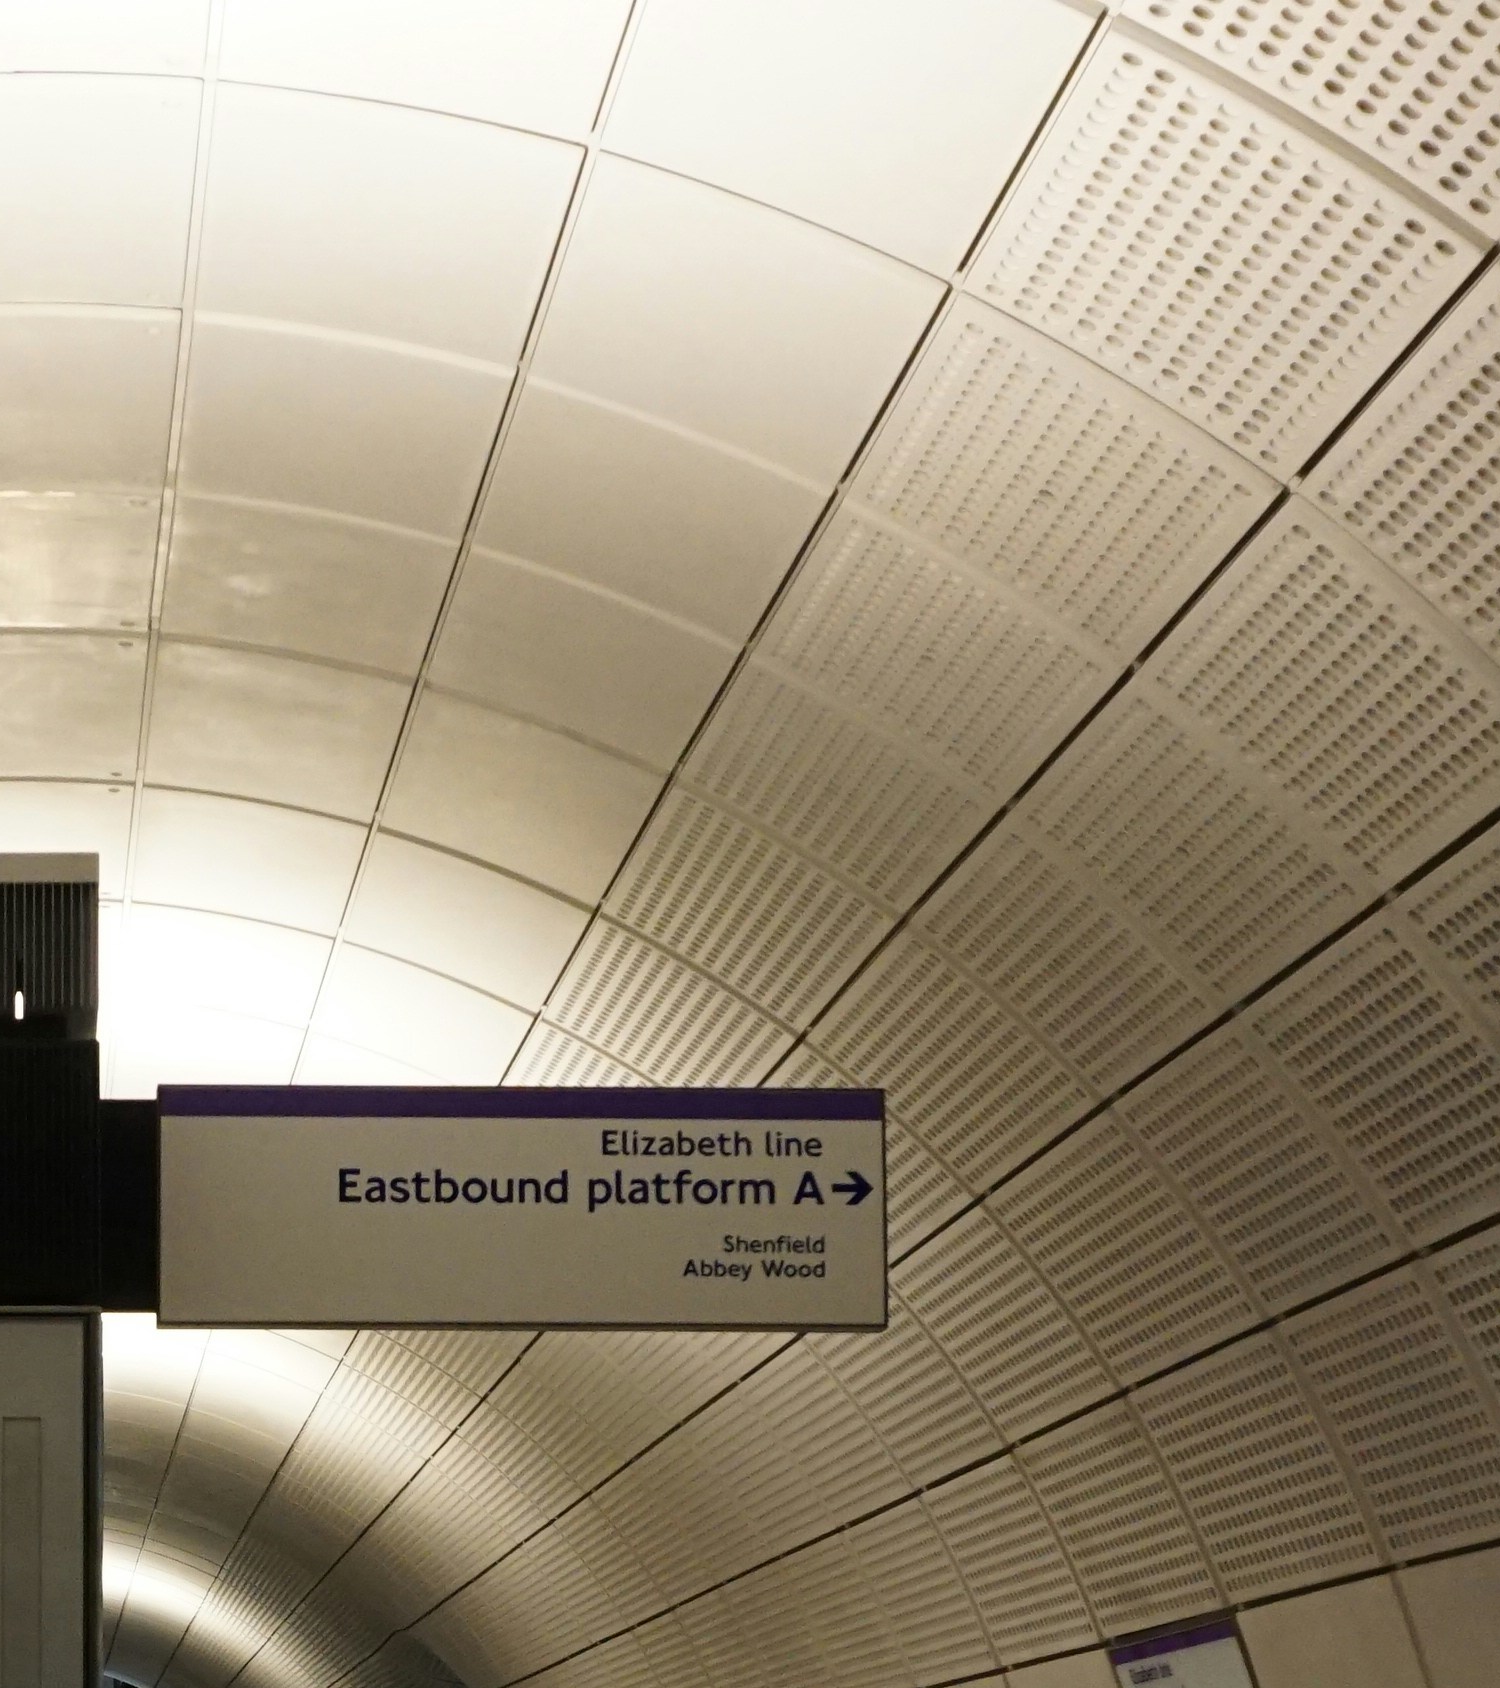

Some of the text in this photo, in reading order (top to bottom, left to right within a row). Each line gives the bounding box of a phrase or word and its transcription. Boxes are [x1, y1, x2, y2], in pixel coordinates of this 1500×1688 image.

[601, 1129, 823, 1159] Elizabeth line
[338, 1168, 826, 1214] Eastbound platform A
[723, 1234, 826, 1255] Shenfield
[682, 1258, 826, 1283] Abbey Wood
